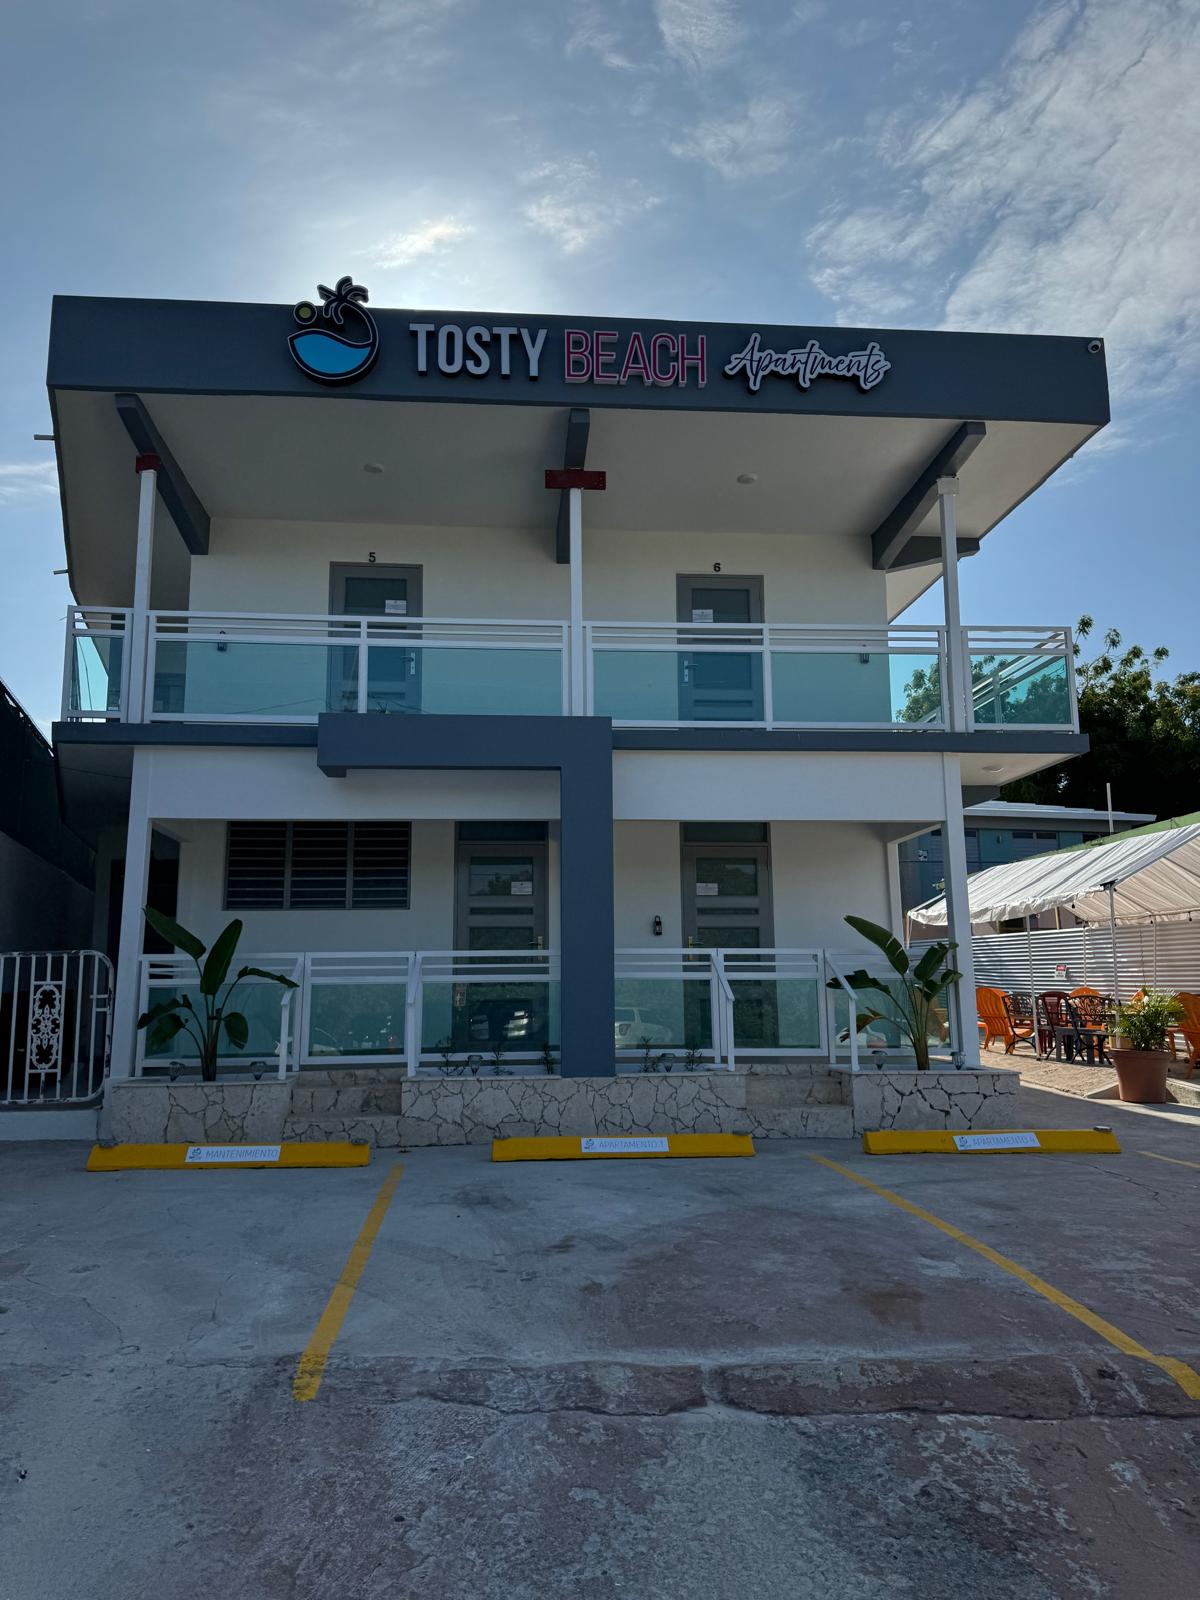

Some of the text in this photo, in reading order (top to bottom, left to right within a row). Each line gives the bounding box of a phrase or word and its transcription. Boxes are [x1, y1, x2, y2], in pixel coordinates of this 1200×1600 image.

[409, 323, 892, 391] TOSTY BEACH Apartments
[368, 551, 376, 563] 5
[713, 562, 721, 573] 6
[599, 1140, 658, 1149] APARTAMENTO
[973, 1135, 1029, 1145] APARTAMENTO
[205, 1149, 279, 1159] MANTENIMIENTO
